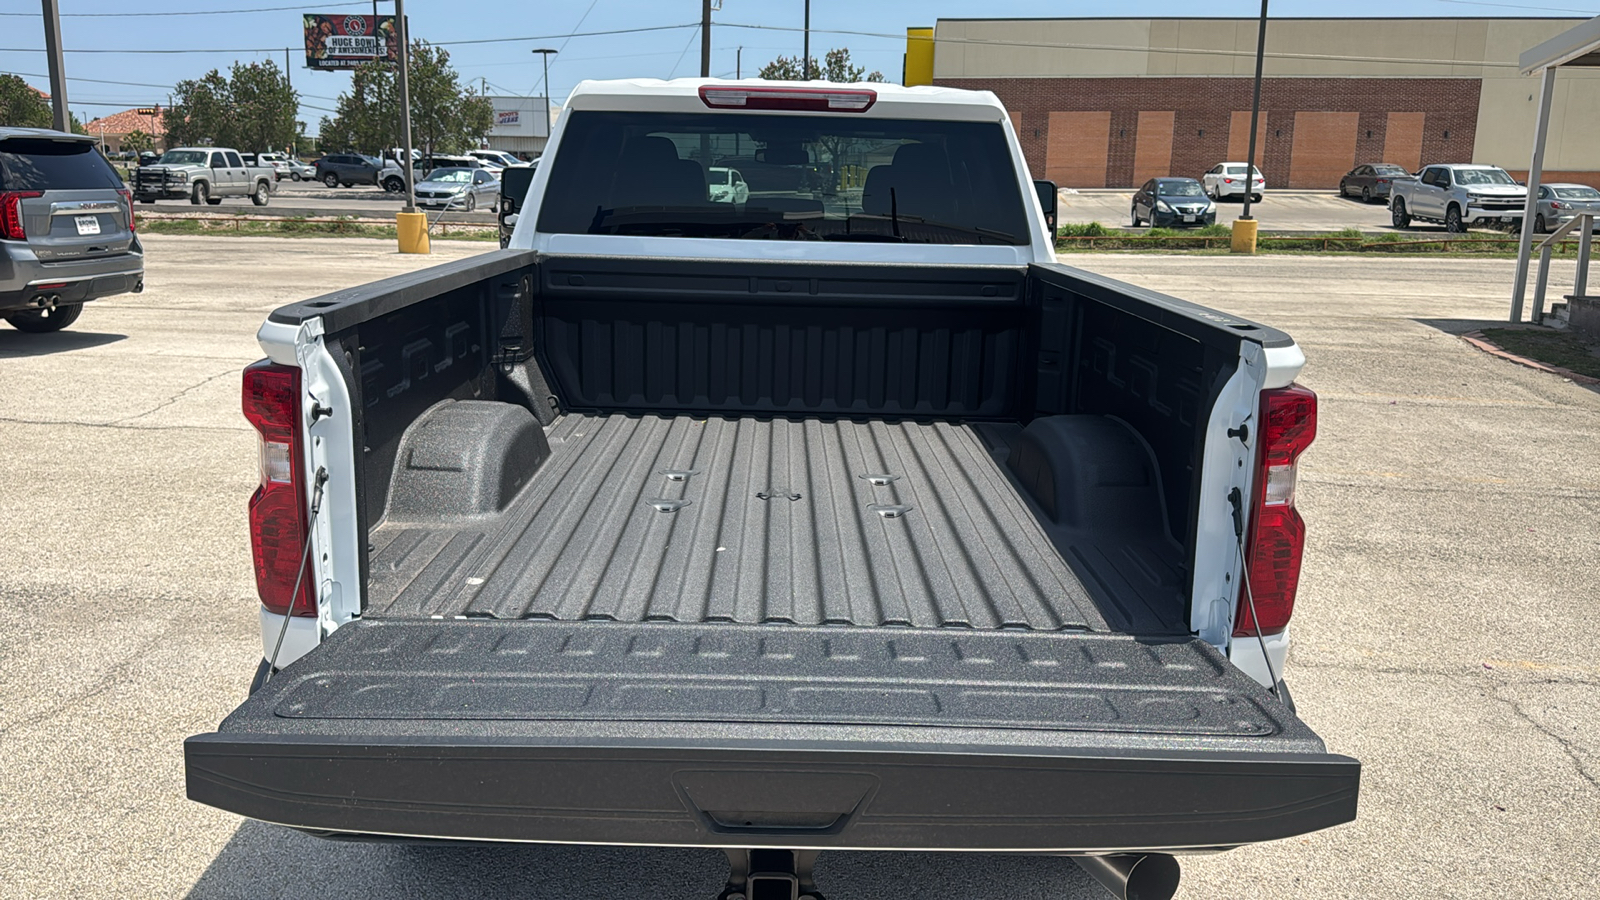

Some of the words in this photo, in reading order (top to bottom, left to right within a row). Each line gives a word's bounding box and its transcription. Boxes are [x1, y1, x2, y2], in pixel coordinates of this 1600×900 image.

[332, 38, 352, 46] HUGE
[355, 38, 381, 47] BOWL
[338, 47, 386, 55] AWESOMENES!
